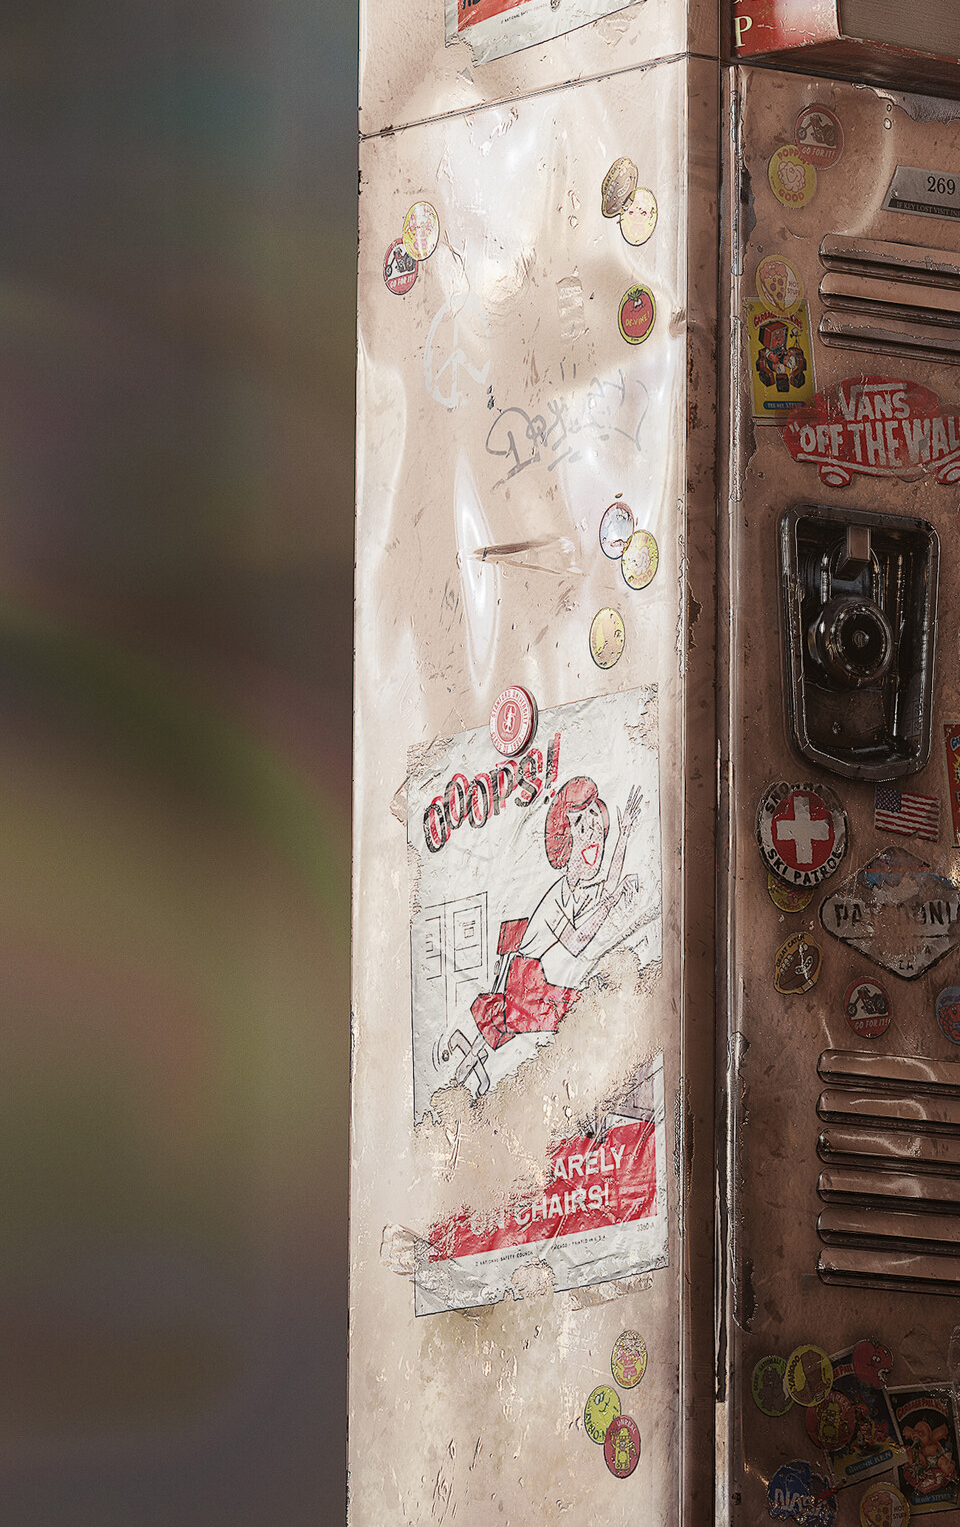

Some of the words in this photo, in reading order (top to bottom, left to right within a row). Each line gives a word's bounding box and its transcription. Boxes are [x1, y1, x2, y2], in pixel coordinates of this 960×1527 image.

[801, 146, 811, 155] GO
[812, 147, 824, 156] FOR
[825, 149, 835, 159] IT!
[927, 175, 956, 195] 269
[778, 188, 805, 203] GOOD
[903, 202, 916, 210] KEY
[916, 204, 932, 213] LOST
[933, 206, 950, 215] VISIT
[838, 382, 911, 421] VANS
[847, 420, 900, 468] THE
[768, 848, 789, 876] SKI
[854, 1020, 866, 1030] GO
[866, 1019, 879, 1029] FOR
[514, 1185, 611, 1226] CHAIRS!
